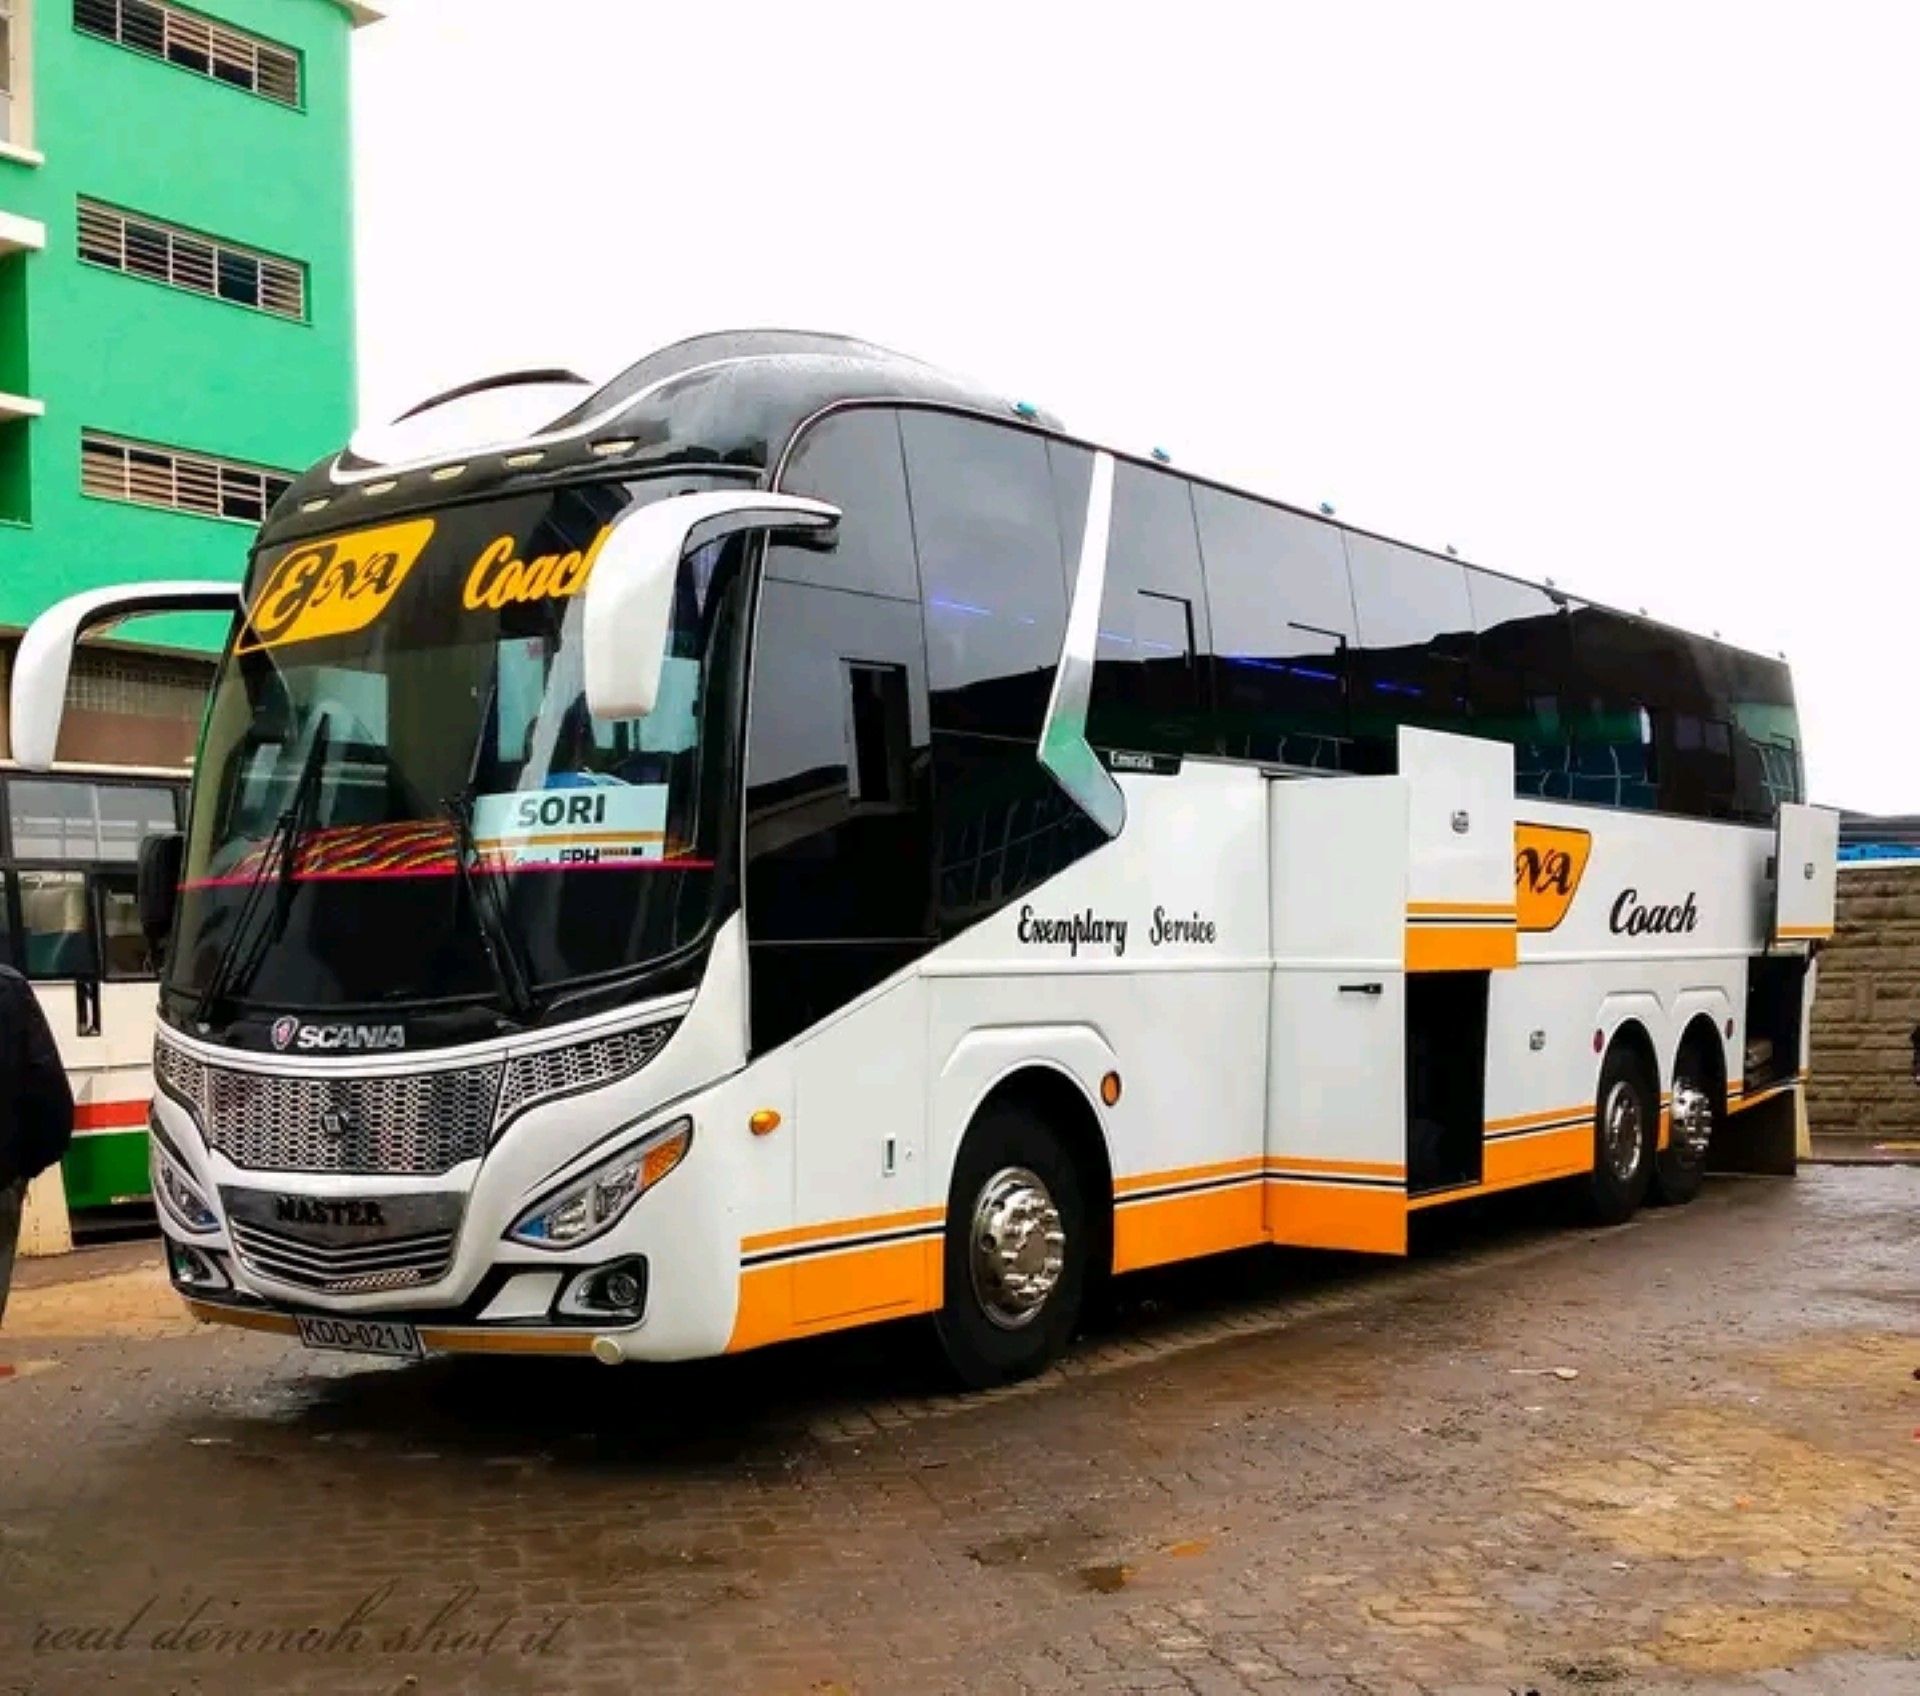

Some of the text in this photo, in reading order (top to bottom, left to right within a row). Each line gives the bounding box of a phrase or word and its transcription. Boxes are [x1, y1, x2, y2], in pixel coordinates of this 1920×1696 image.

[518, 794, 605, 827] SORI
[1516, 846, 1699, 937] NA Coach
[1018, 905, 1216, 957] Exemplary Service
[297, 1024, 405, 1049] SCANIA
[276, 1194, 385, 1227] MASTER
